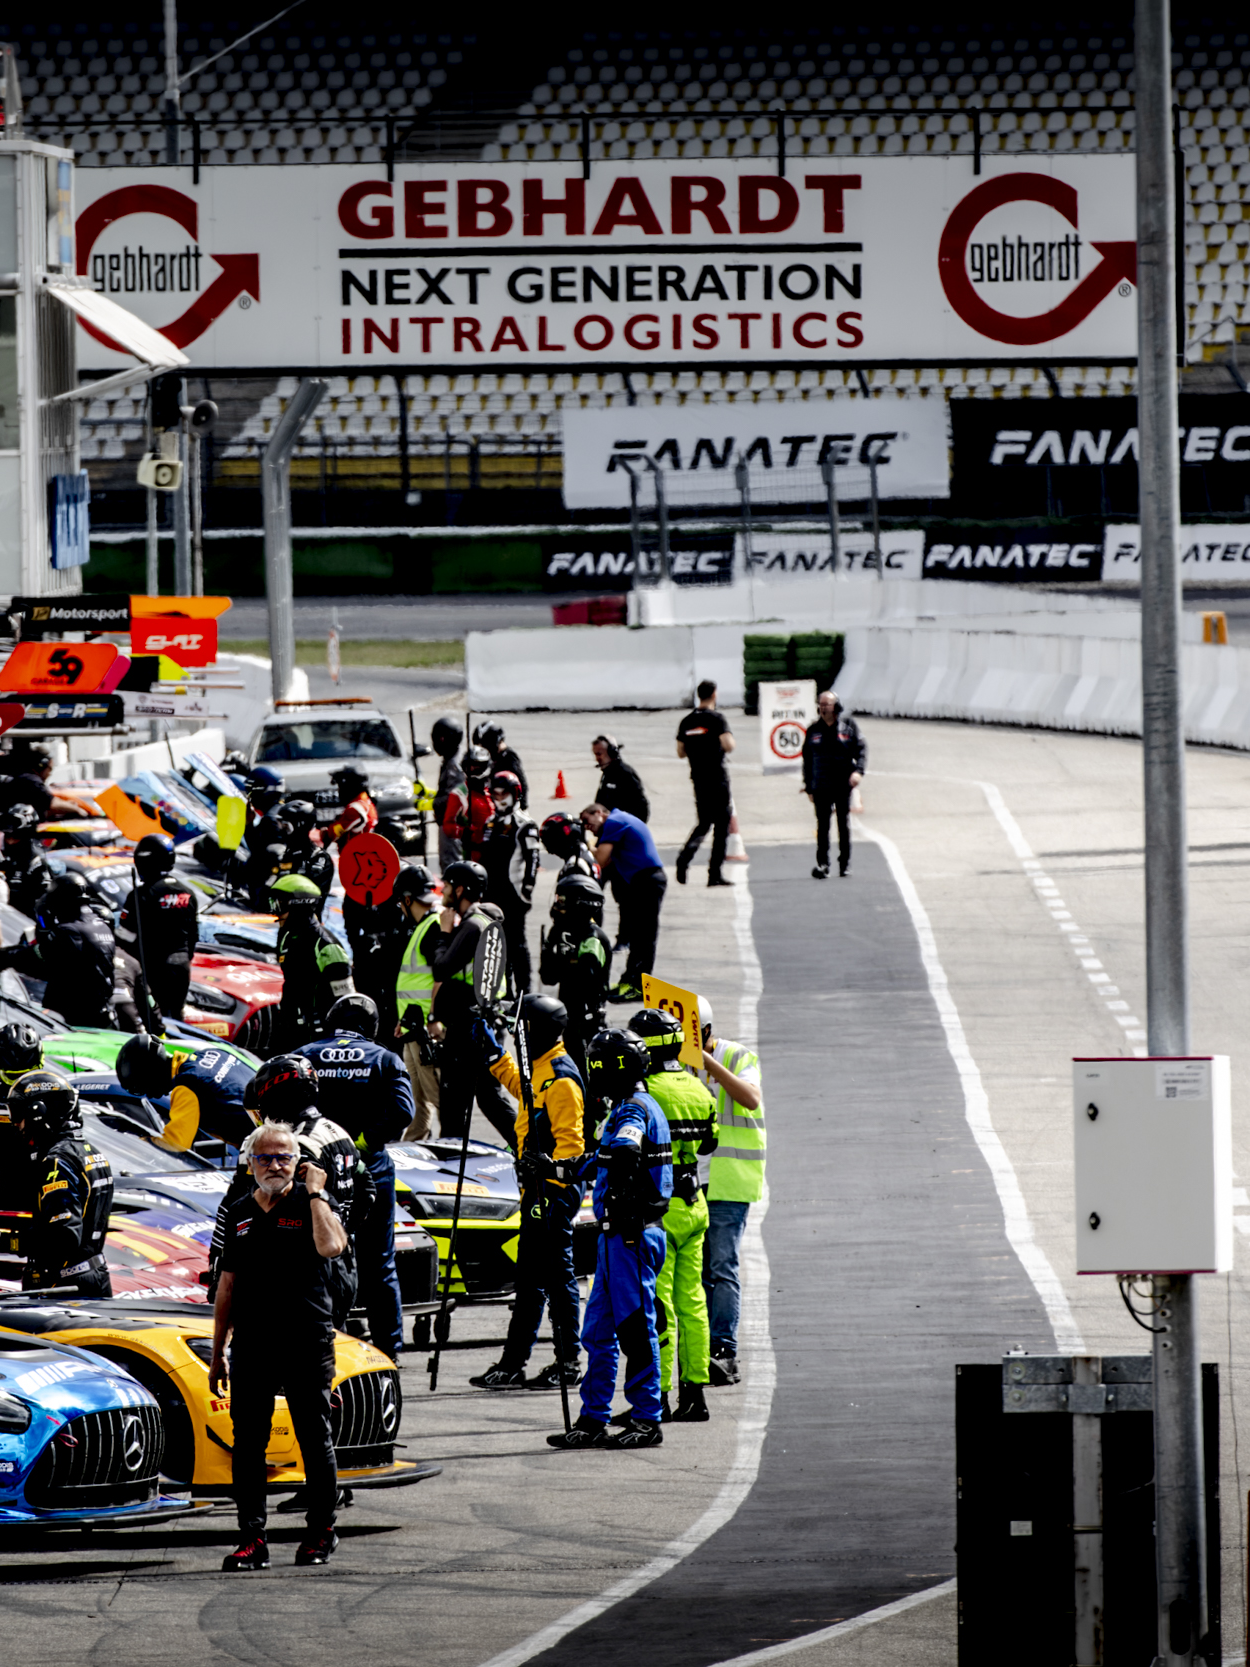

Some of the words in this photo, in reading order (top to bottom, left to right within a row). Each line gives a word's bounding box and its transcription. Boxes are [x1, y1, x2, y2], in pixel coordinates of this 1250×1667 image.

[338, 174, 862, 240] GEBHARDT
[92, 246, 202, 293] gebhardt
[969, 234, 1082, 283] gebhardt
[341, 266, 489, 305] NEXT
[507, 262, 862, 304] GENERATION
[342, 312, 864, 354] INTRALOGISTICS
[606, 432, 897, 473] FANATEC
[989, 425, 1250, 465] FANAEC
[547, 551, 727, 575] FANATEC
[750, 550, 910, 571] FANATEC
[924, 543, 1096, 569] FANATEC
[50, 607, 128, 621] Motorsport
[778, 731, 801, 748] 50
[278, 1217, 303, 1227] SRO
